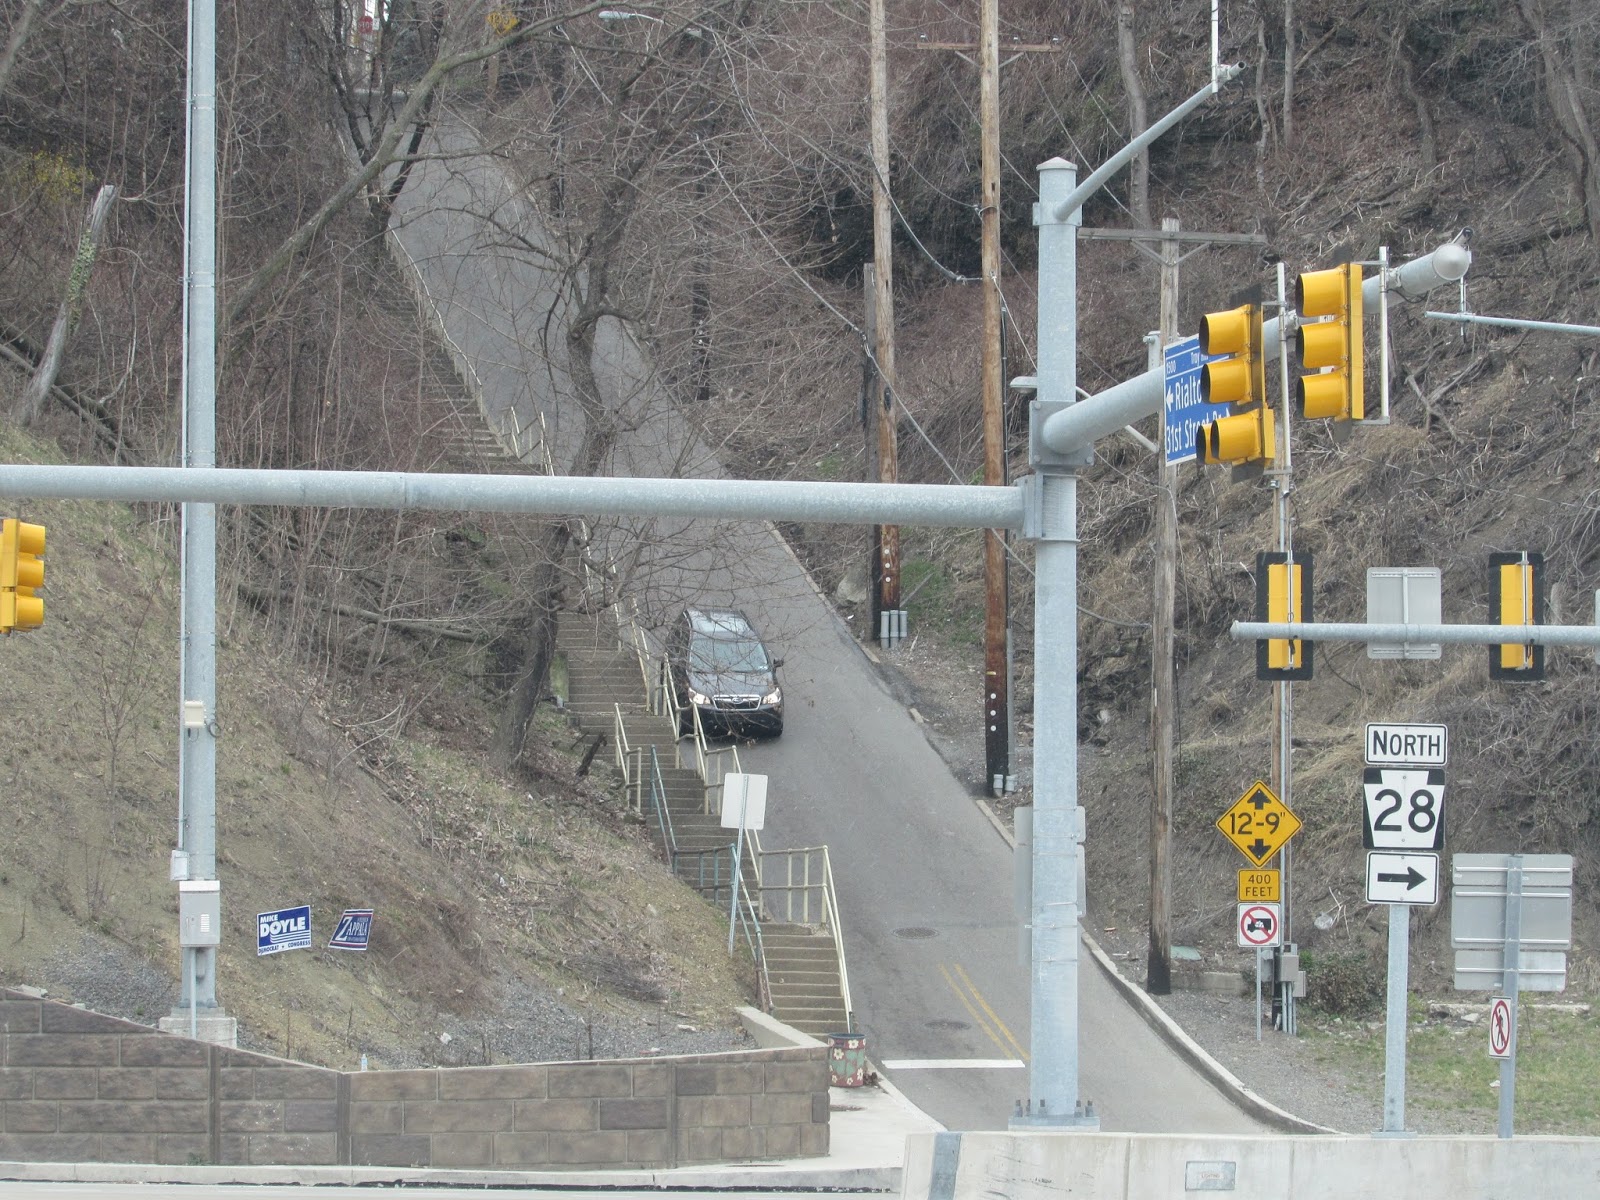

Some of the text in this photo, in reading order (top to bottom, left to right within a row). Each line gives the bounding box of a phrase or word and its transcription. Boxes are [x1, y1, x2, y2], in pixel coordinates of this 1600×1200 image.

[1166, 421, 1182, 454] 31st
[1373, 730, 1441, 757] NORTH
[1373, 788, 1436, 833] 28
[1247, 874, 1271, 885] 400
[1245, 886, 1273, 897] FEET
[260, 913, 279, 924] MIKE
[259, 916, 306, 938] DOYLE
[287, 939, 311, 949] CONGRESS
